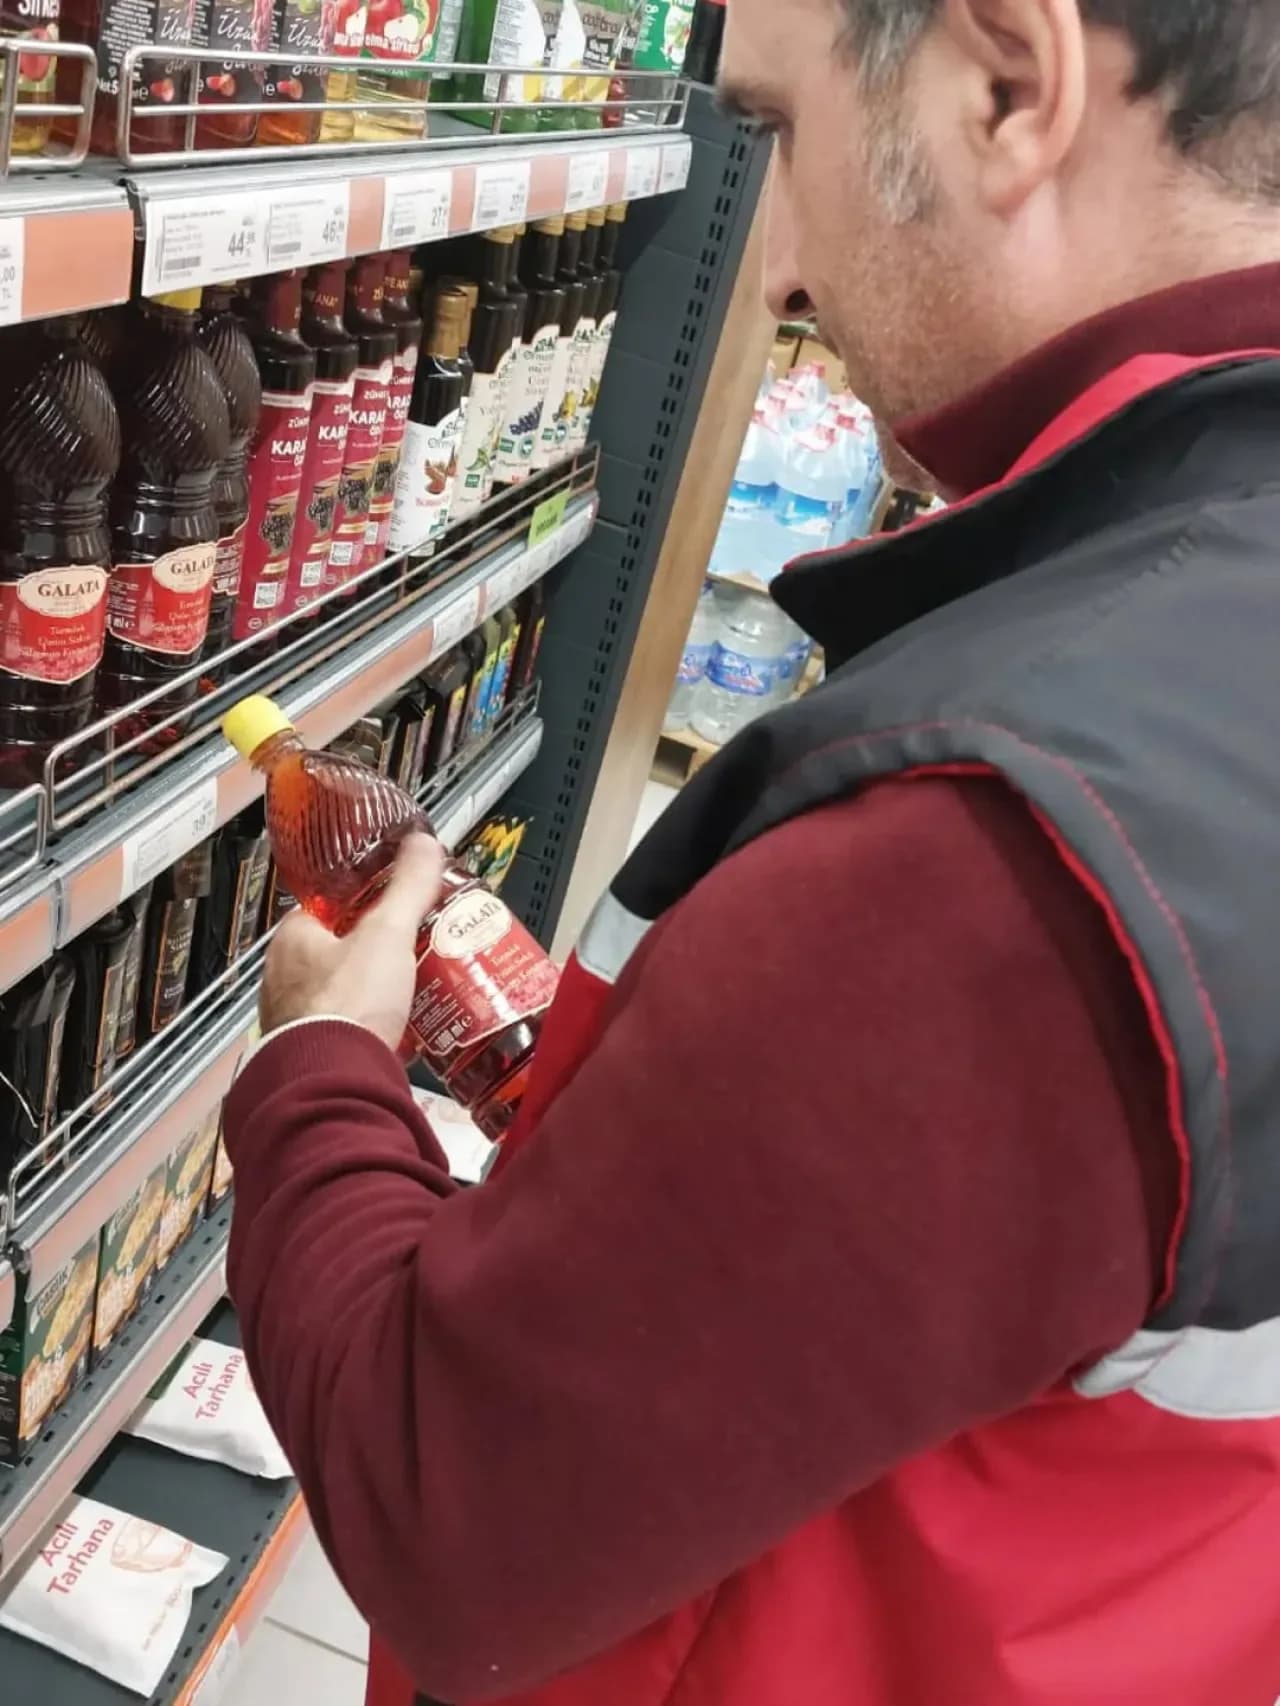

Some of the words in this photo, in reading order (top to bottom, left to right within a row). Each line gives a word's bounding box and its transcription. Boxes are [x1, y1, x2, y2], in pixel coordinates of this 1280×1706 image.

[37, 580, 101, 599] GALATA
[195, 1353, 244, 1420] Tarhana
[46, 1517, 115, 1595] Tarhana
